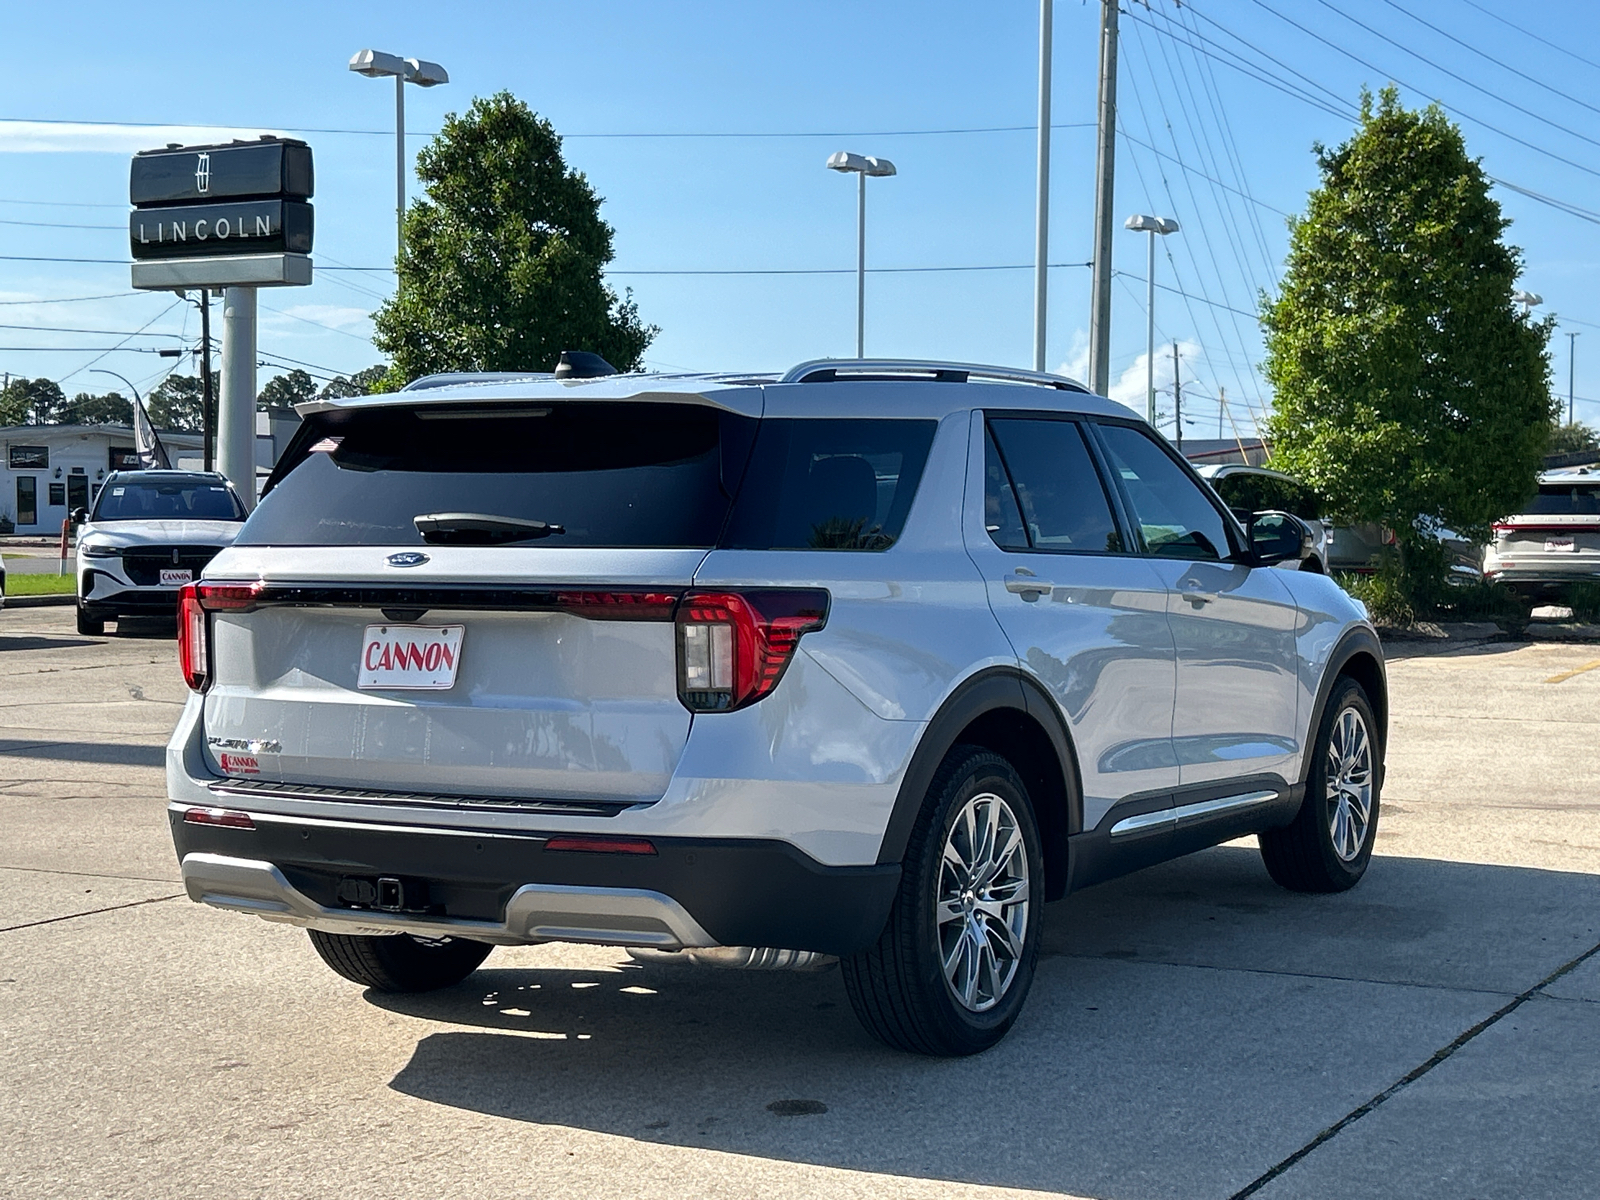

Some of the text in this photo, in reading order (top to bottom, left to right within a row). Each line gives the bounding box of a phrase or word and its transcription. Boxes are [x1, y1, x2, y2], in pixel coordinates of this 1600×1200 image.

[140, 215, 270, 244] LINCOLN
[162, 572, 190, 581] CANNON
[365, 641, 457, 672] CANNON
[228, 755, 259, 768] CANNON
